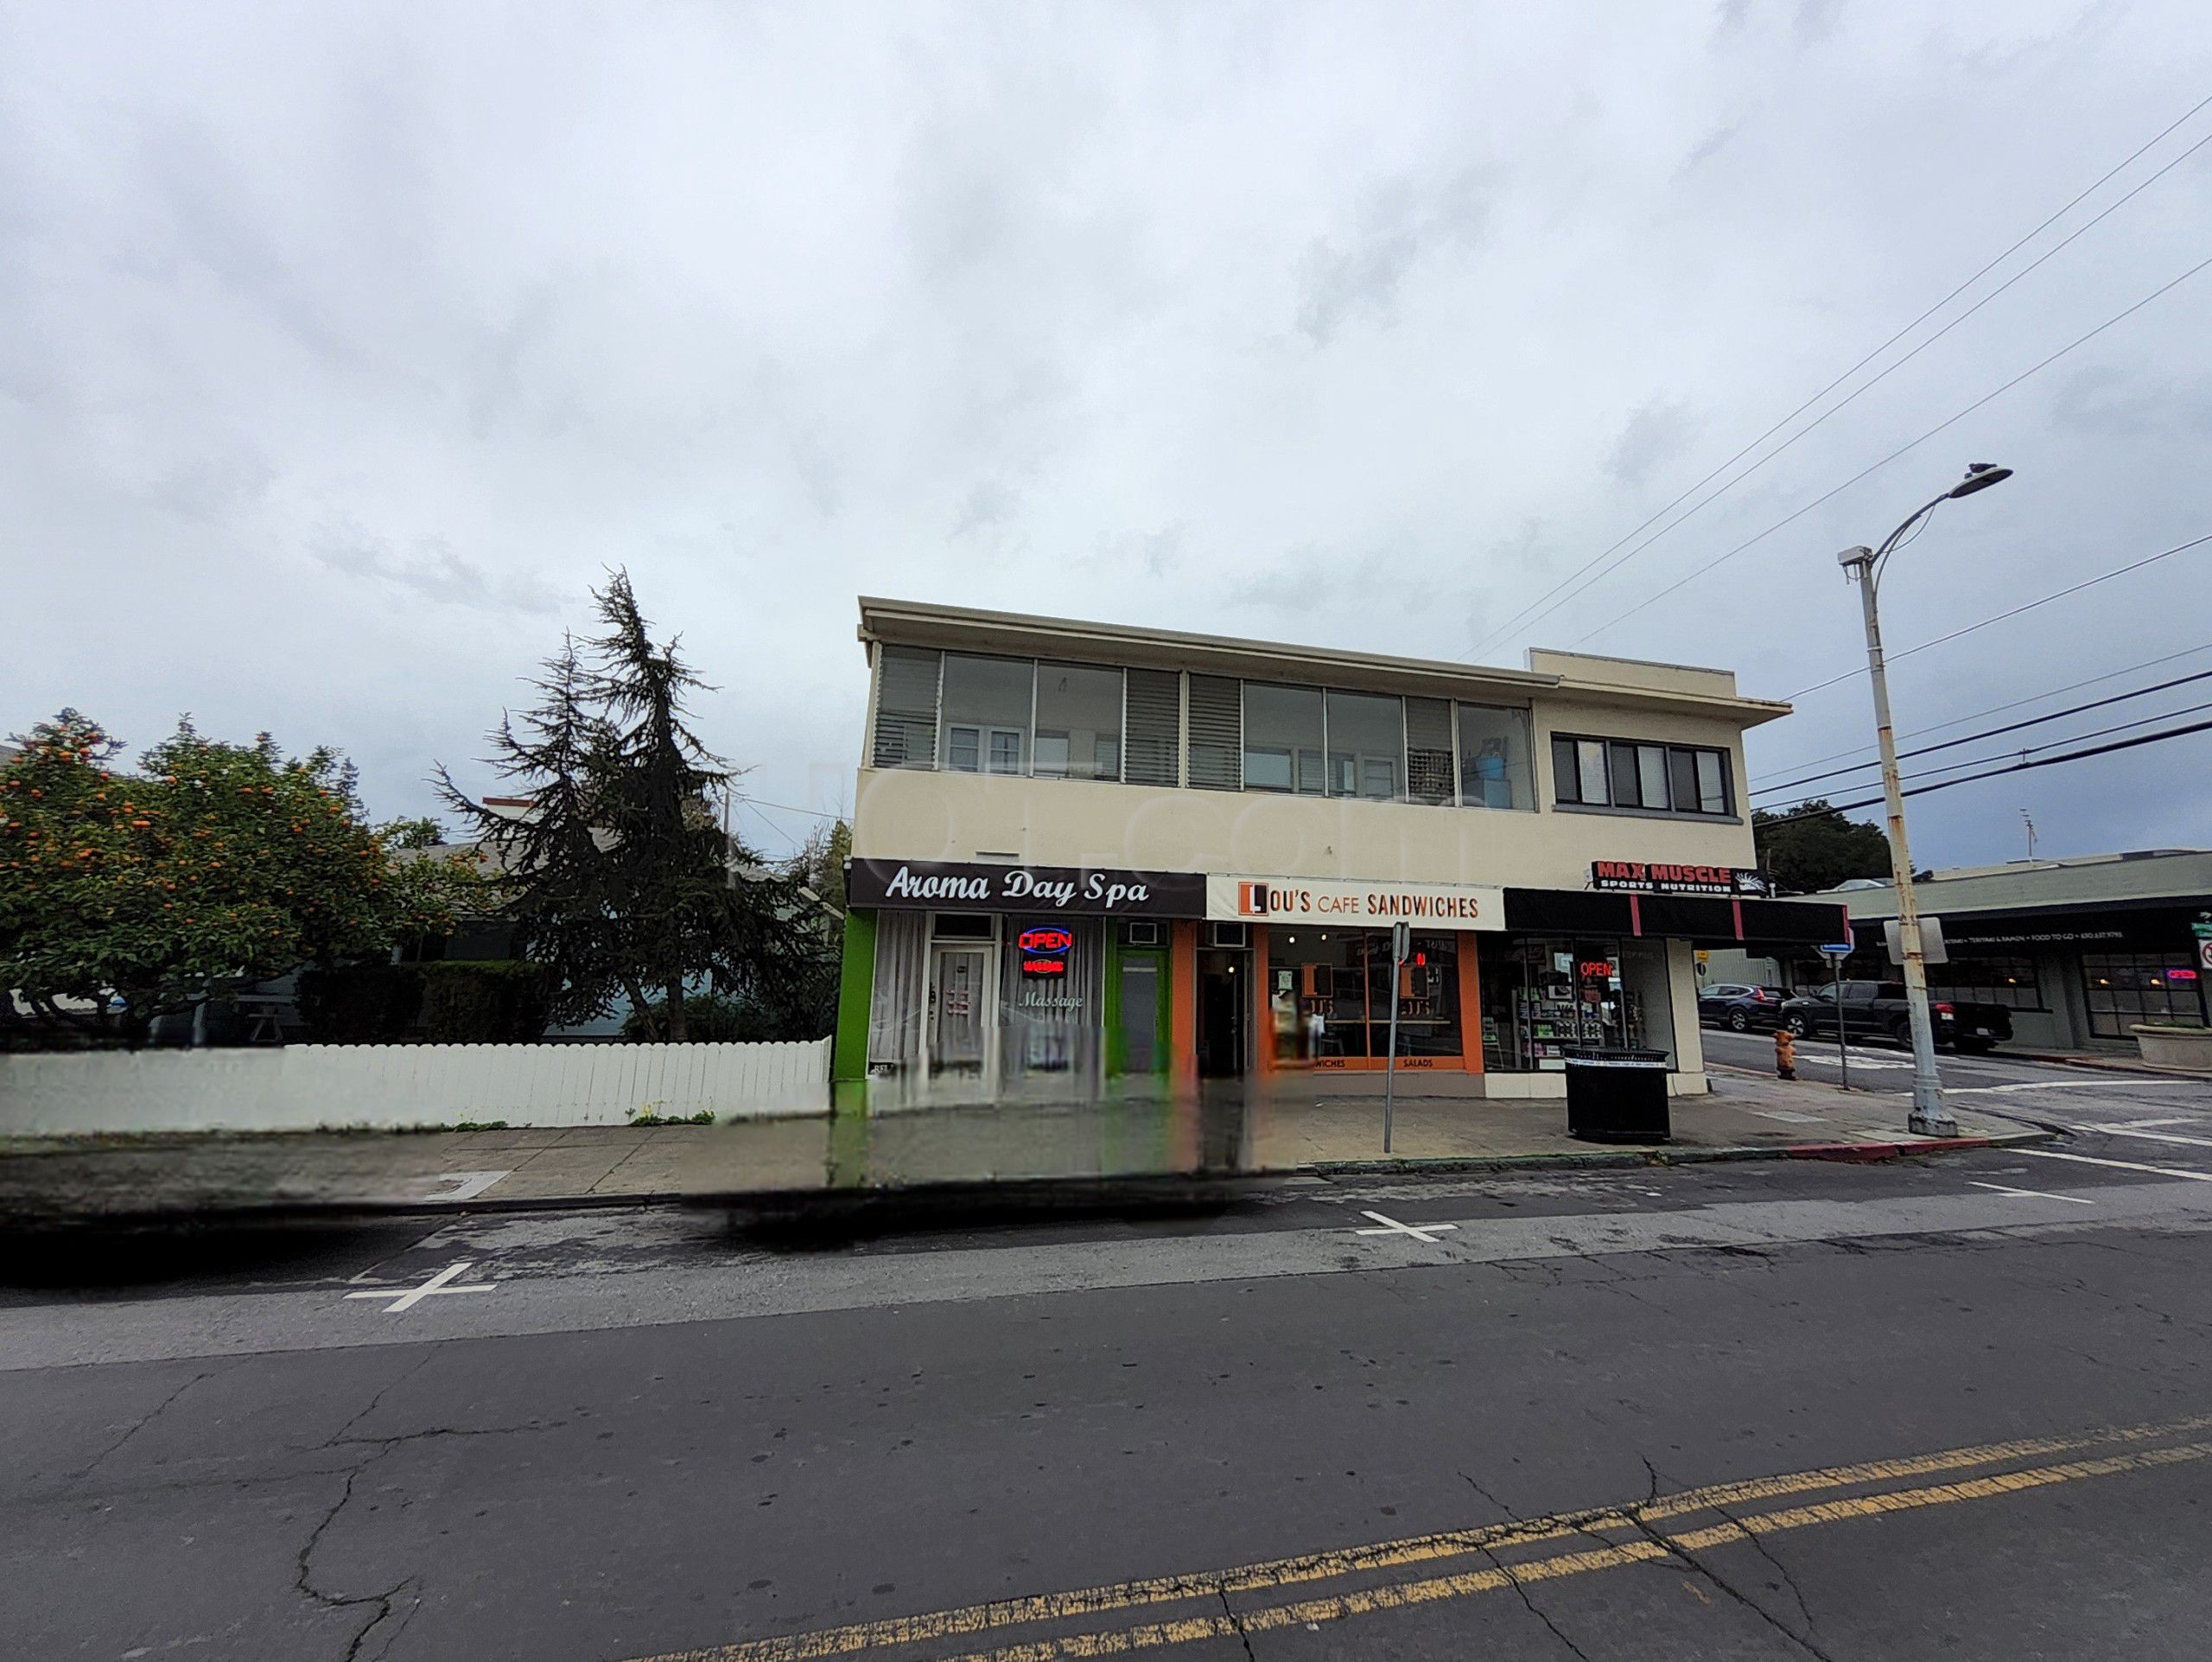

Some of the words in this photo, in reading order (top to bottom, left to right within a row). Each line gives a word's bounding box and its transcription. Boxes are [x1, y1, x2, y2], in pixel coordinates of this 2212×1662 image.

[1597, 861, 1646, 880] MAX
[1650, 864, 1732, 883] MUSCLE
[885, 865, 991, 900] Aroma
[1001, 869, 1077, 906] Day
[1084, 873, 1150, 908] Spa
[1600, 880, 1654, 890] SPORTS
[1661, 882, 1732, 893] NUTRITION
[1238, 882, 1311, 916] LOU'S
[1318, 895, 1359, 914] CAFE
[1367, 893, 1479, 919] SANDWICHES
[1018, 932, 1073, 949] OPEN
[1580, 962, 1612, 977] OPEN
[1018, 990, 1084, 1012] Massage
[1403, 1059, 1433, 1068] SALADS
